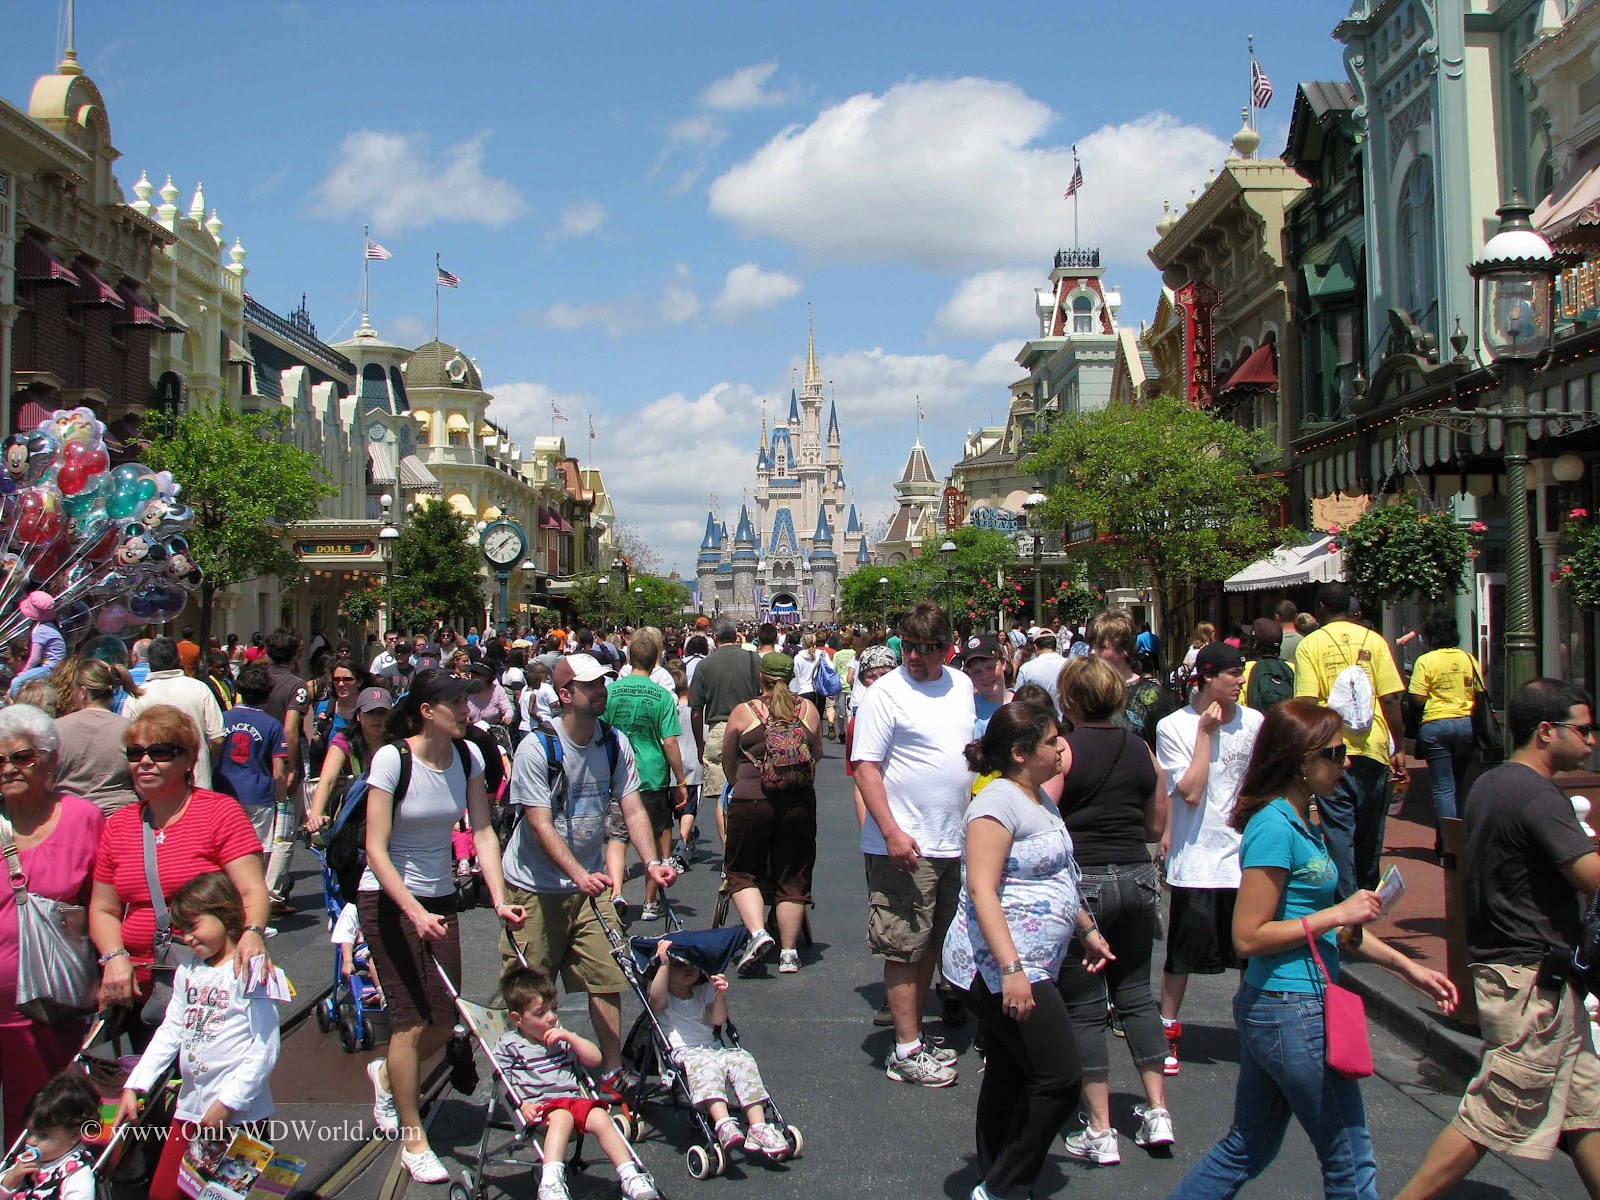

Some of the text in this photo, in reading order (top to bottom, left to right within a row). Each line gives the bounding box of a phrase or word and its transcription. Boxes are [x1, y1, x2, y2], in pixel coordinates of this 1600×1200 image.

[315, 544, 352, 554] DOLLS
[295, 688, 308, 703] 3
[224, 722, 264, 742] HACKETT
[230, 732, 251, 764] 3
